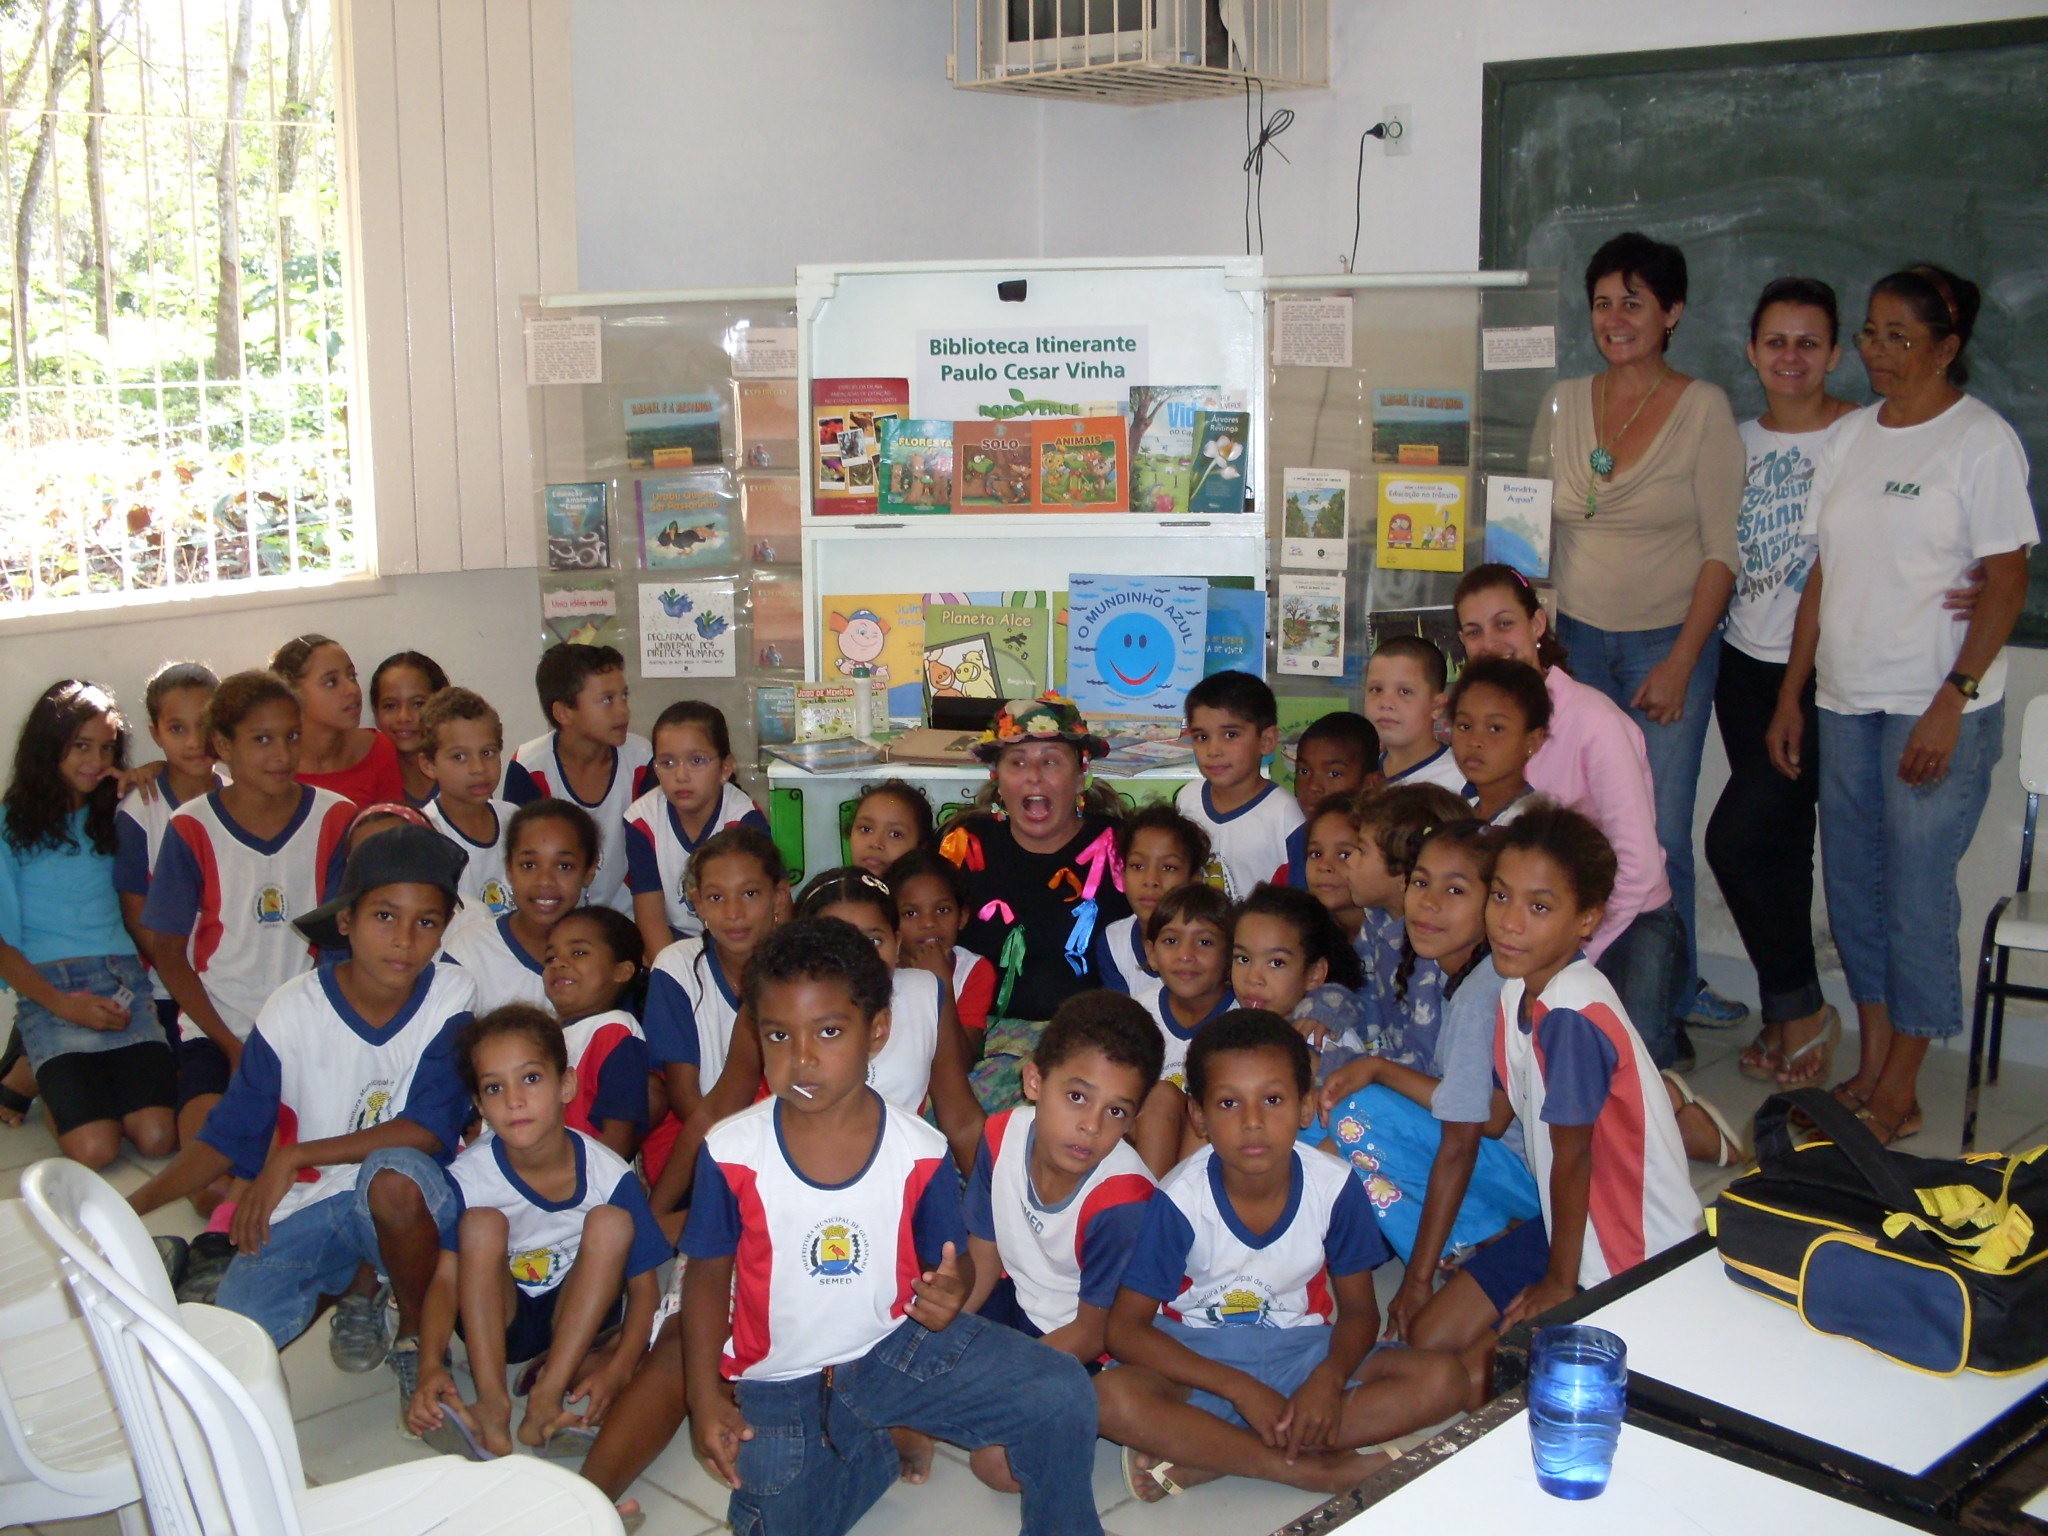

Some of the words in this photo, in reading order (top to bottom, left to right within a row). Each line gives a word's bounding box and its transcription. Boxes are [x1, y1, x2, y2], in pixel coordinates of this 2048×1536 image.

[929, 337, 1029, 356] Biblioteca
[1035, 336, 1137, 354] Itinerante
[941, 363, 998, 381] Paulo
[1003, 363, 1060, 380] Cesar
[1065, 361, 1126, 379] Vinha
[898, 437, 953, 448] FLORESTA
[981, 438, 1020, 450] SOLO
[1055, 435, 1102, 447] ANIMAIS
[942, 610, 995, 626] Planeta
[999, 613, 1032, 627] Alce
[1077, 624, 1090, 639] O
[1085, 592, 1164, 625] MUNDINHO
[1164, 605, 1193, 645] AZUL
[646, 649, 682, 658] DIREITOS
[686, 649, 726, 658] HUMANOS
[797, 689, 815, 698] JOGO
[816, 688, 825, 697] DE
[814, 1216, 850, 1231] MUNICIPAL
[850, 1221, 860, 1231] DE
[819, 1277, 853, 1286] SEMED
